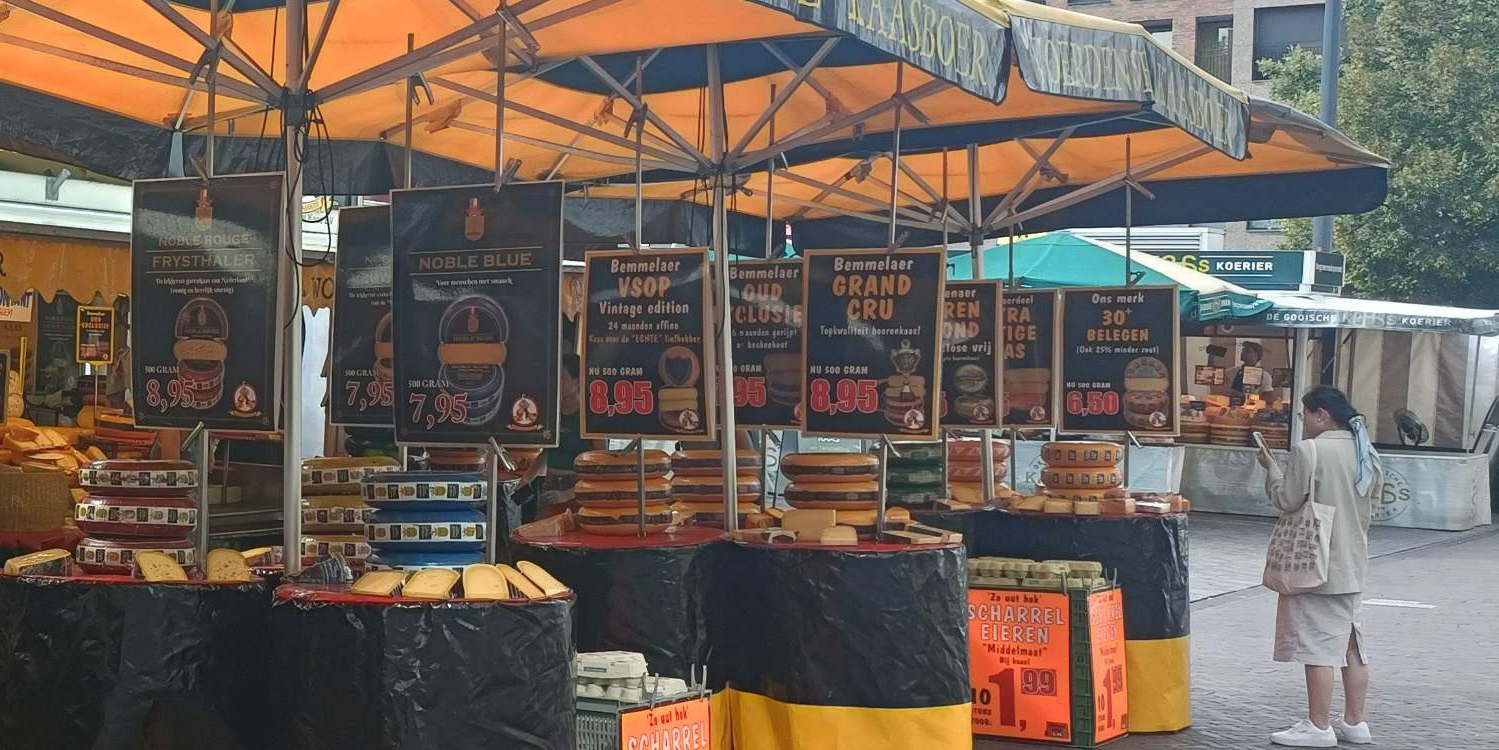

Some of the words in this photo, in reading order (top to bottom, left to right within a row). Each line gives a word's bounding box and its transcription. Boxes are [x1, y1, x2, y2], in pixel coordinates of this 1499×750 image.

[158, 235, 201, 248] NOBLE
[204, 233, 250, 246] ROUGE
[152, 253, 255, 268] FRYSTHALER
[419, 256, 478, 271] NOBLE
[483, 252, 532, 268] BLUE
[610, 257, 681, 274] Bemmelaer
[834, 256, 914, 272] Bemmelaer
[1216, 261, 1273, 271] KOERIER
[730, 265, 799, 280] Bemmelaer
[618, 275, 671, 298] VSOP
[742, 283, 783, 302] OUD
[832, 274, 912, 298] GRAND
[1092, 293, 1112, 304] Ons
[1117, 291, 1145, 304] merk
[599, 301, 642, 318] Vintage
[647, 299, 689, 314] edition
[847, 298, 895, 321] CRU
[608, 321, 619, 330] 24
[1267, 313, 1279, 321] DE
[1284, 313, 1337, 322] GOOISCHE
[1401, 317, 1450, 327] KOERIER
[820, 325, 868, 337] Topkwaliteit
[871, 325, 921, 336] boerenkaas!
[1087, 329, 1149, 342] BELEGEN
[972, 341, 992, 355] vrij
[144, 366, 155, 374] 500
[156, 365, 180, 374] GRAM
[344, 369, 355, 377] 500
[356, 369, 379, 377] GRAM
[589, 368, 599, 376] NU
[602, 368, 617, 376] 500
[620, 367, 643, 376] GRAM
[741, 364, 762, 373] GRAM
[810, 365, 821, 375] NU
[825, 366, 840, 375] 500
[843, 365, 868, 375] GRAM
[408, 380, 421, 388] 500
[422, 379, 450, 388] GRAM
[147, 379, 195, 413] 8,95
[345, 381, 394, 412] 7,95
[589, 379, 654, 417] 8,95
[810, 378, 878, 416] 8,95
[409, 392, 468, 430] 7,95
[1067, 391, 1120, 417] 6,50
[968, 604, 1064, 625] SCHARREL
[981, 624, 1049, 644] EIEREN
[1000, 657, 1009, 665] Bij
[628, 721, 708, 750] SCHARREL
